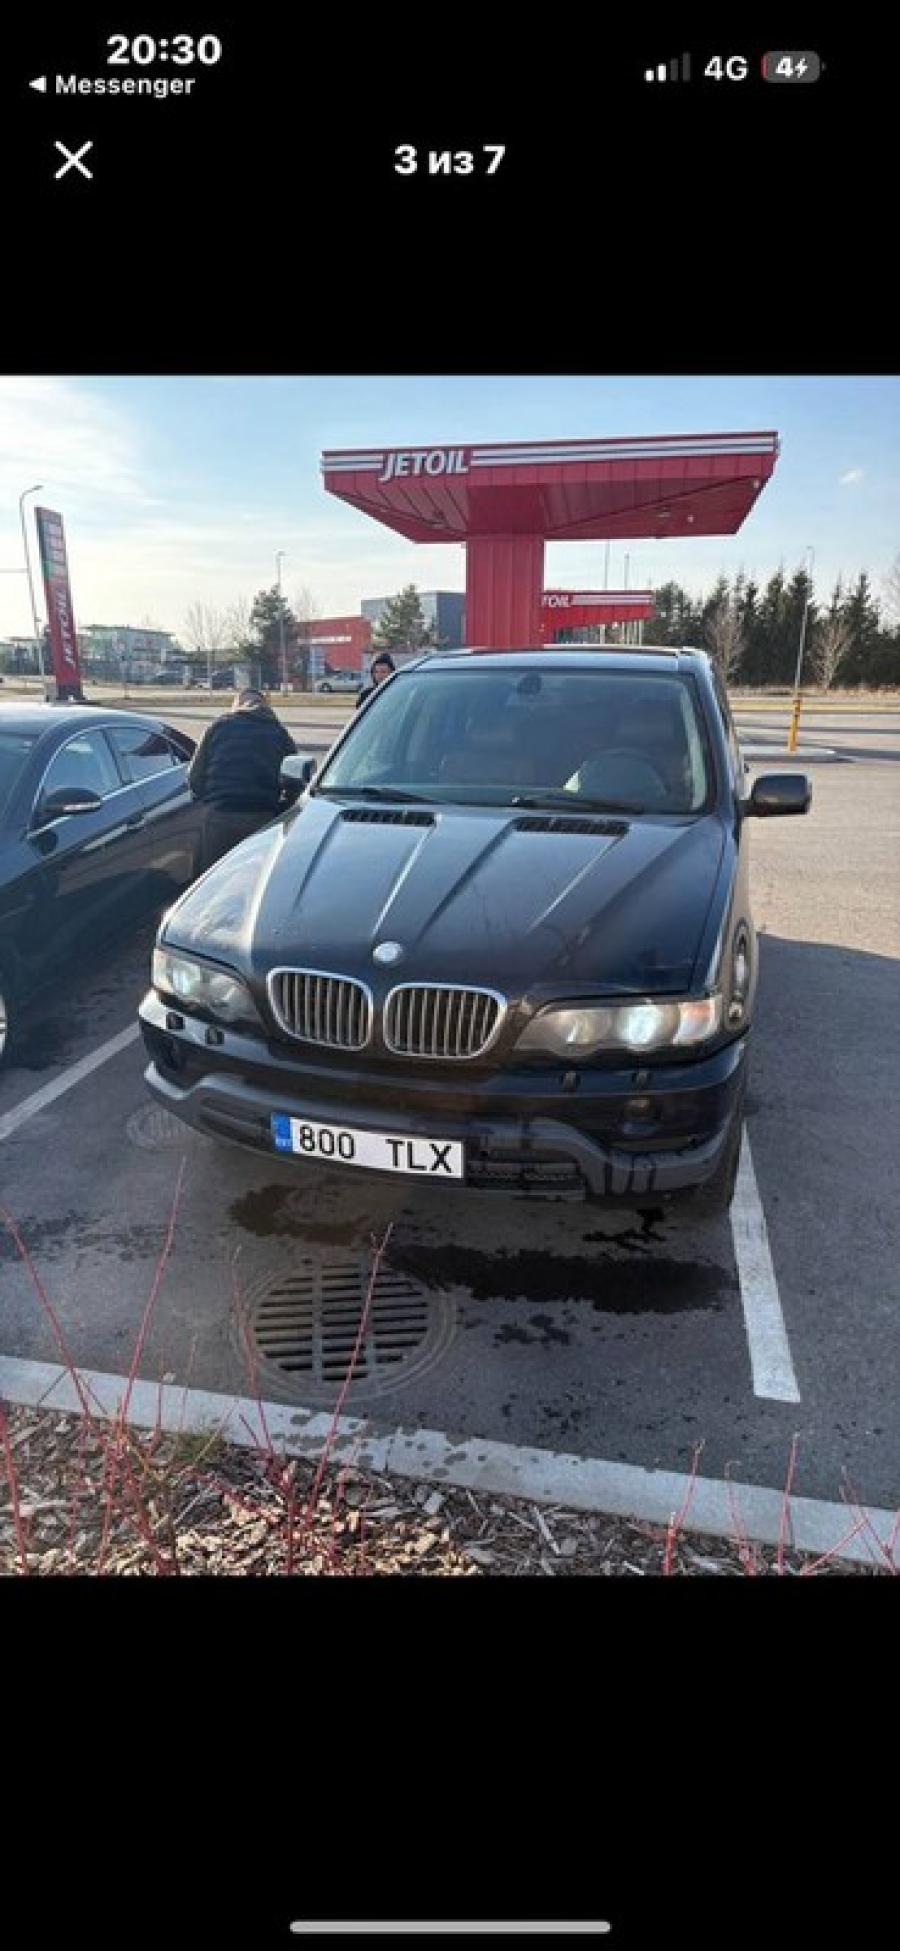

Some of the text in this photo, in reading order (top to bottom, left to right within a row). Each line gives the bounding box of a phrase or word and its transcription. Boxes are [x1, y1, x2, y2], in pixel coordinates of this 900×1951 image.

[378, 450, 469, 482] JETOIL
[299, 1125, 452, 1174] 800 TLX
